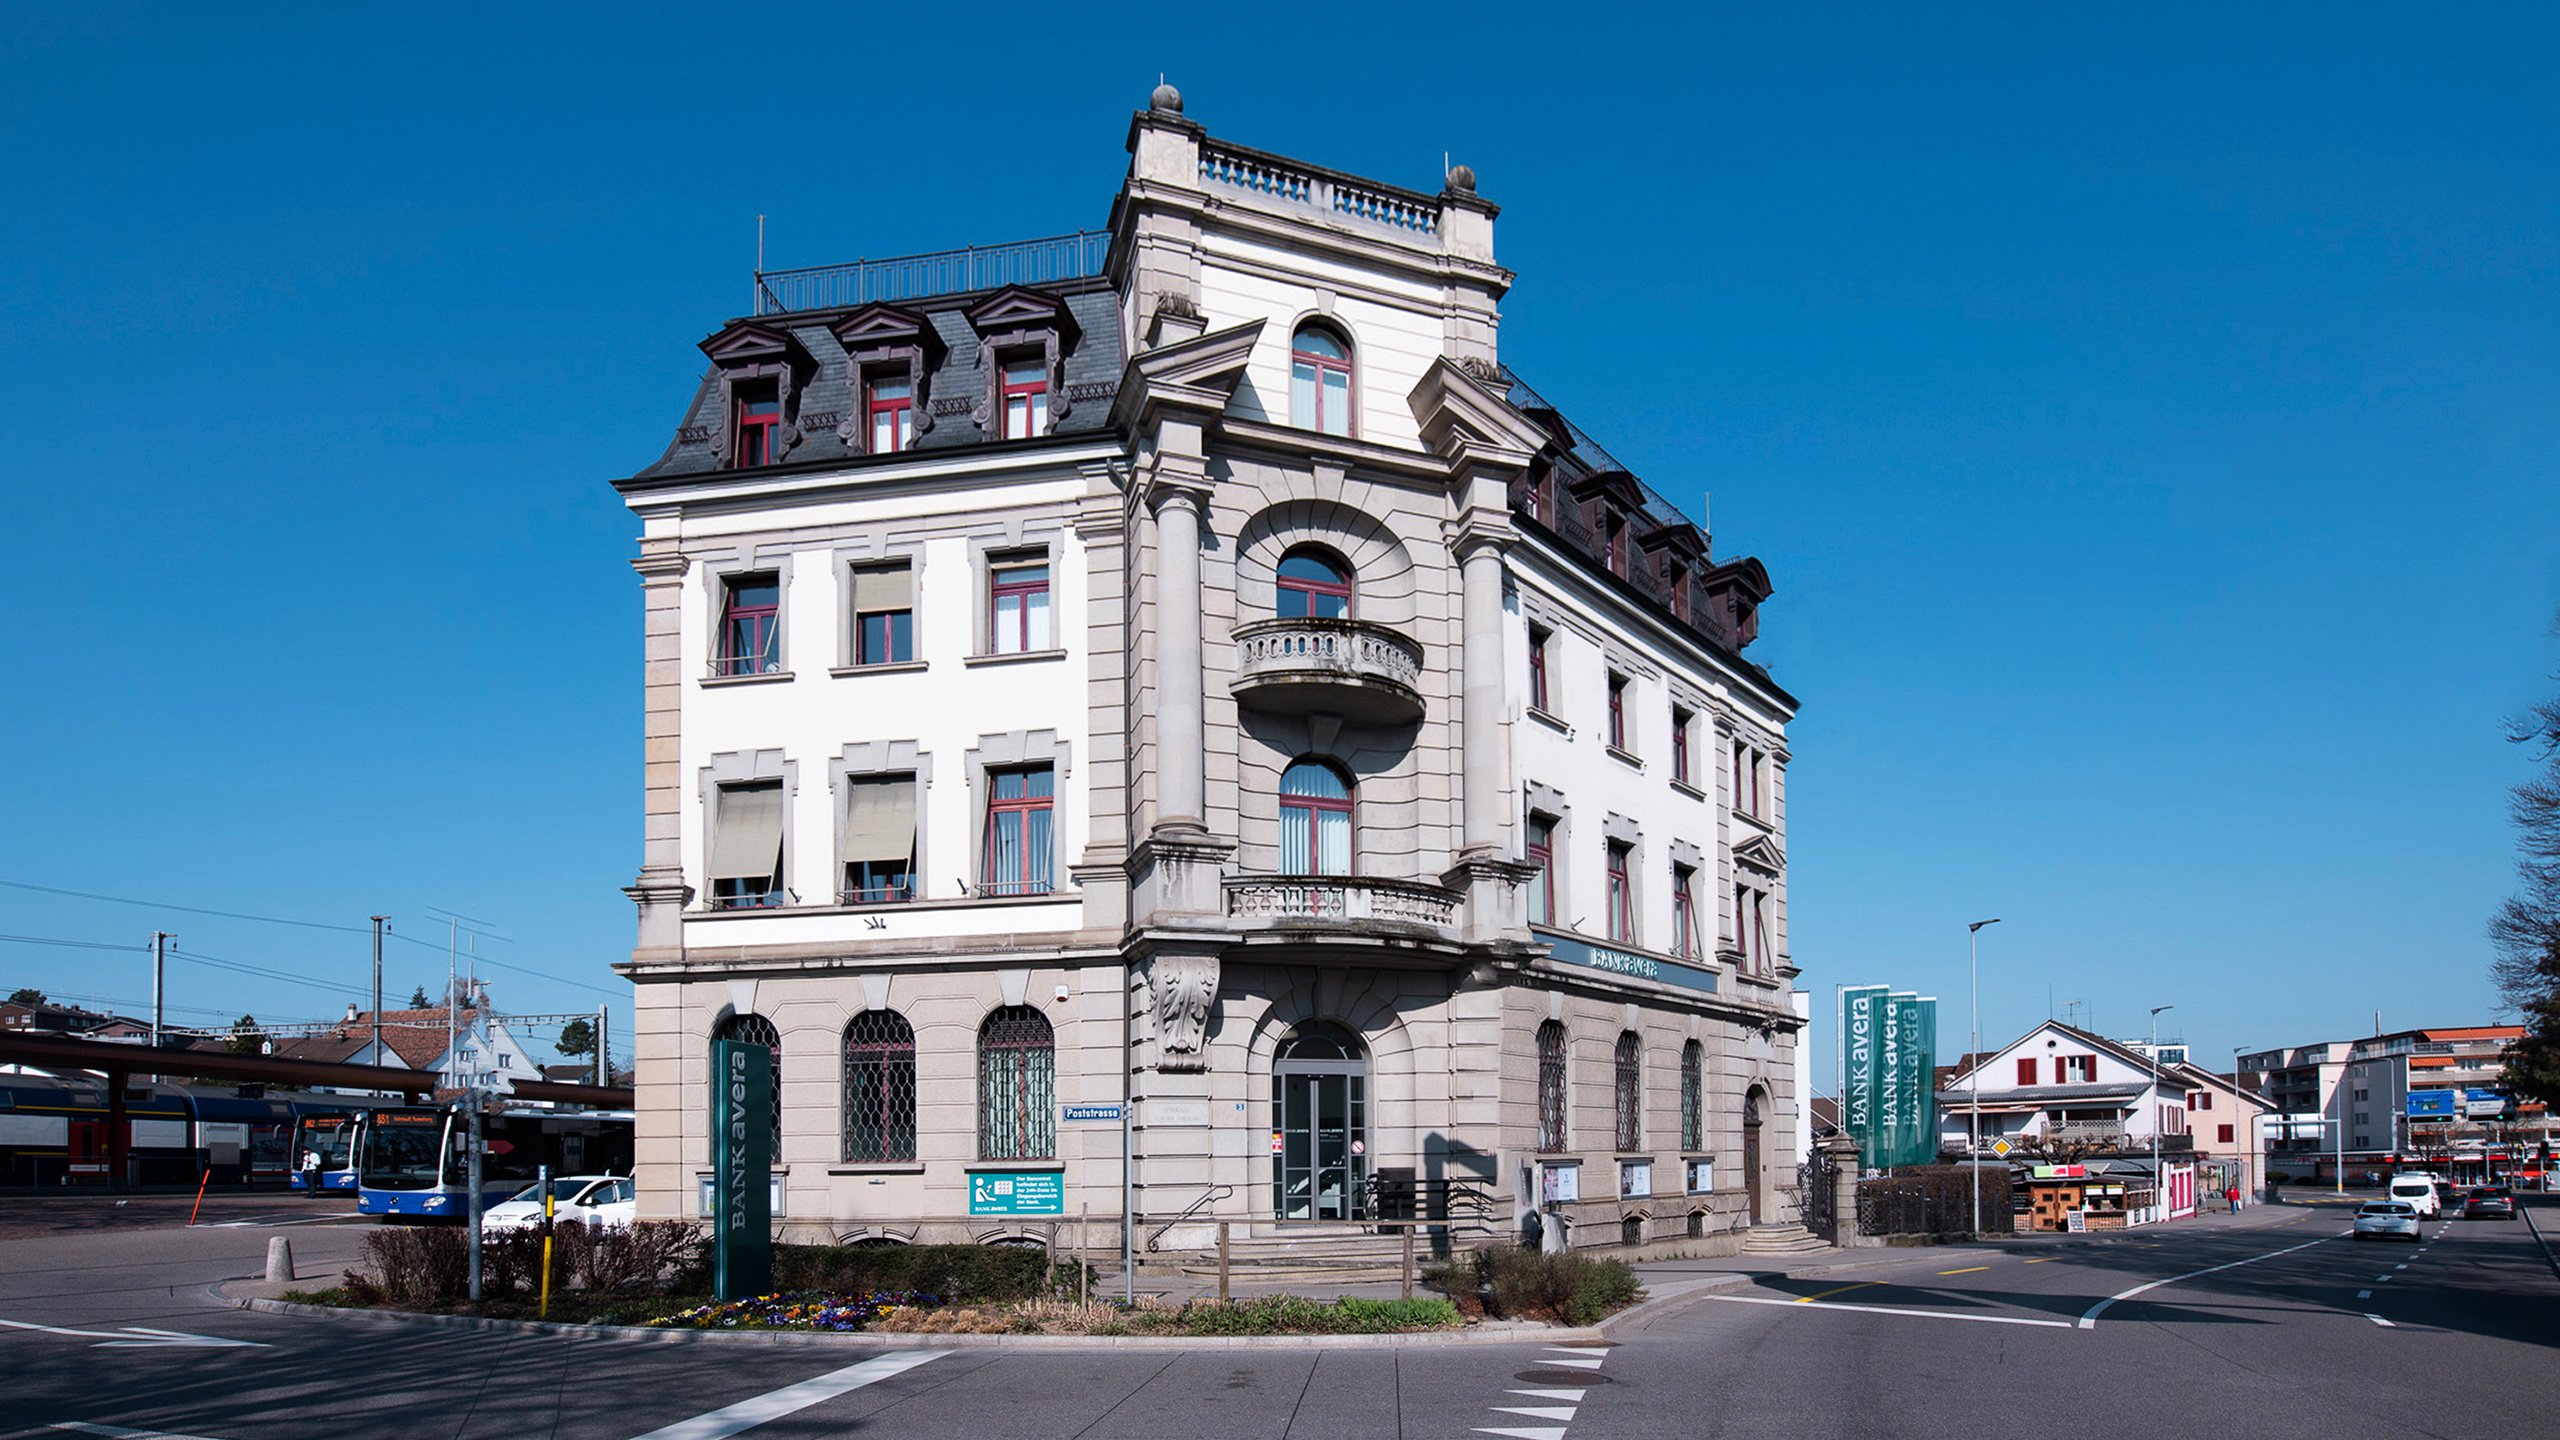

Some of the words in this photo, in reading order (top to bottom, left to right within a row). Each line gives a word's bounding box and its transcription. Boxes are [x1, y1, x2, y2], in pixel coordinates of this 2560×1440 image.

[1590, 948, 1625, 971] BANK
[1625, 955, 1659, 979] avera
[1852, 997, 1869, 1062] avera
[1883, 1002, 1898, 1066] avera
[1903, 1007, 1918, 1067] avera
[732, 1051, 746, 1141] avera
[1067, 1108, 1118, 1118] Poststrasse
[1852, 1063, 1868, 1126] BANK
[1883, 1068, 1898, 1126] BANK
[732, 1144, 746, 1230] BANK
